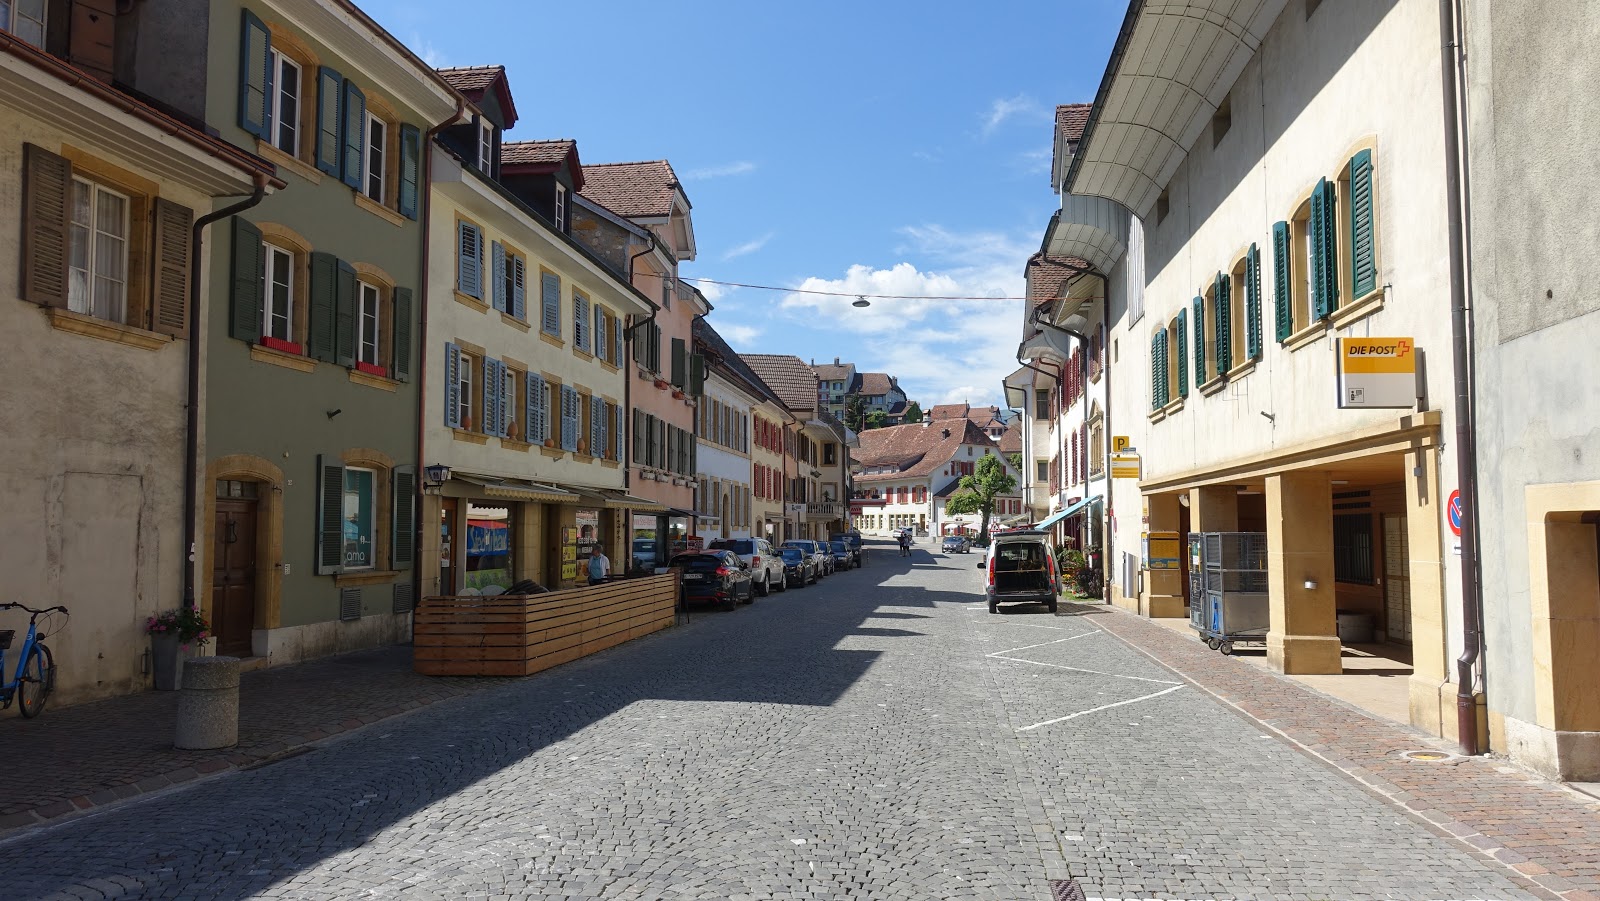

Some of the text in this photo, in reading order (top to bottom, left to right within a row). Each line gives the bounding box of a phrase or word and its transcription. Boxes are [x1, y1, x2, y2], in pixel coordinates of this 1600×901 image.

[1349, 345, 1397, 355] DIE POST
[1117, 437, 1125, 450] P
